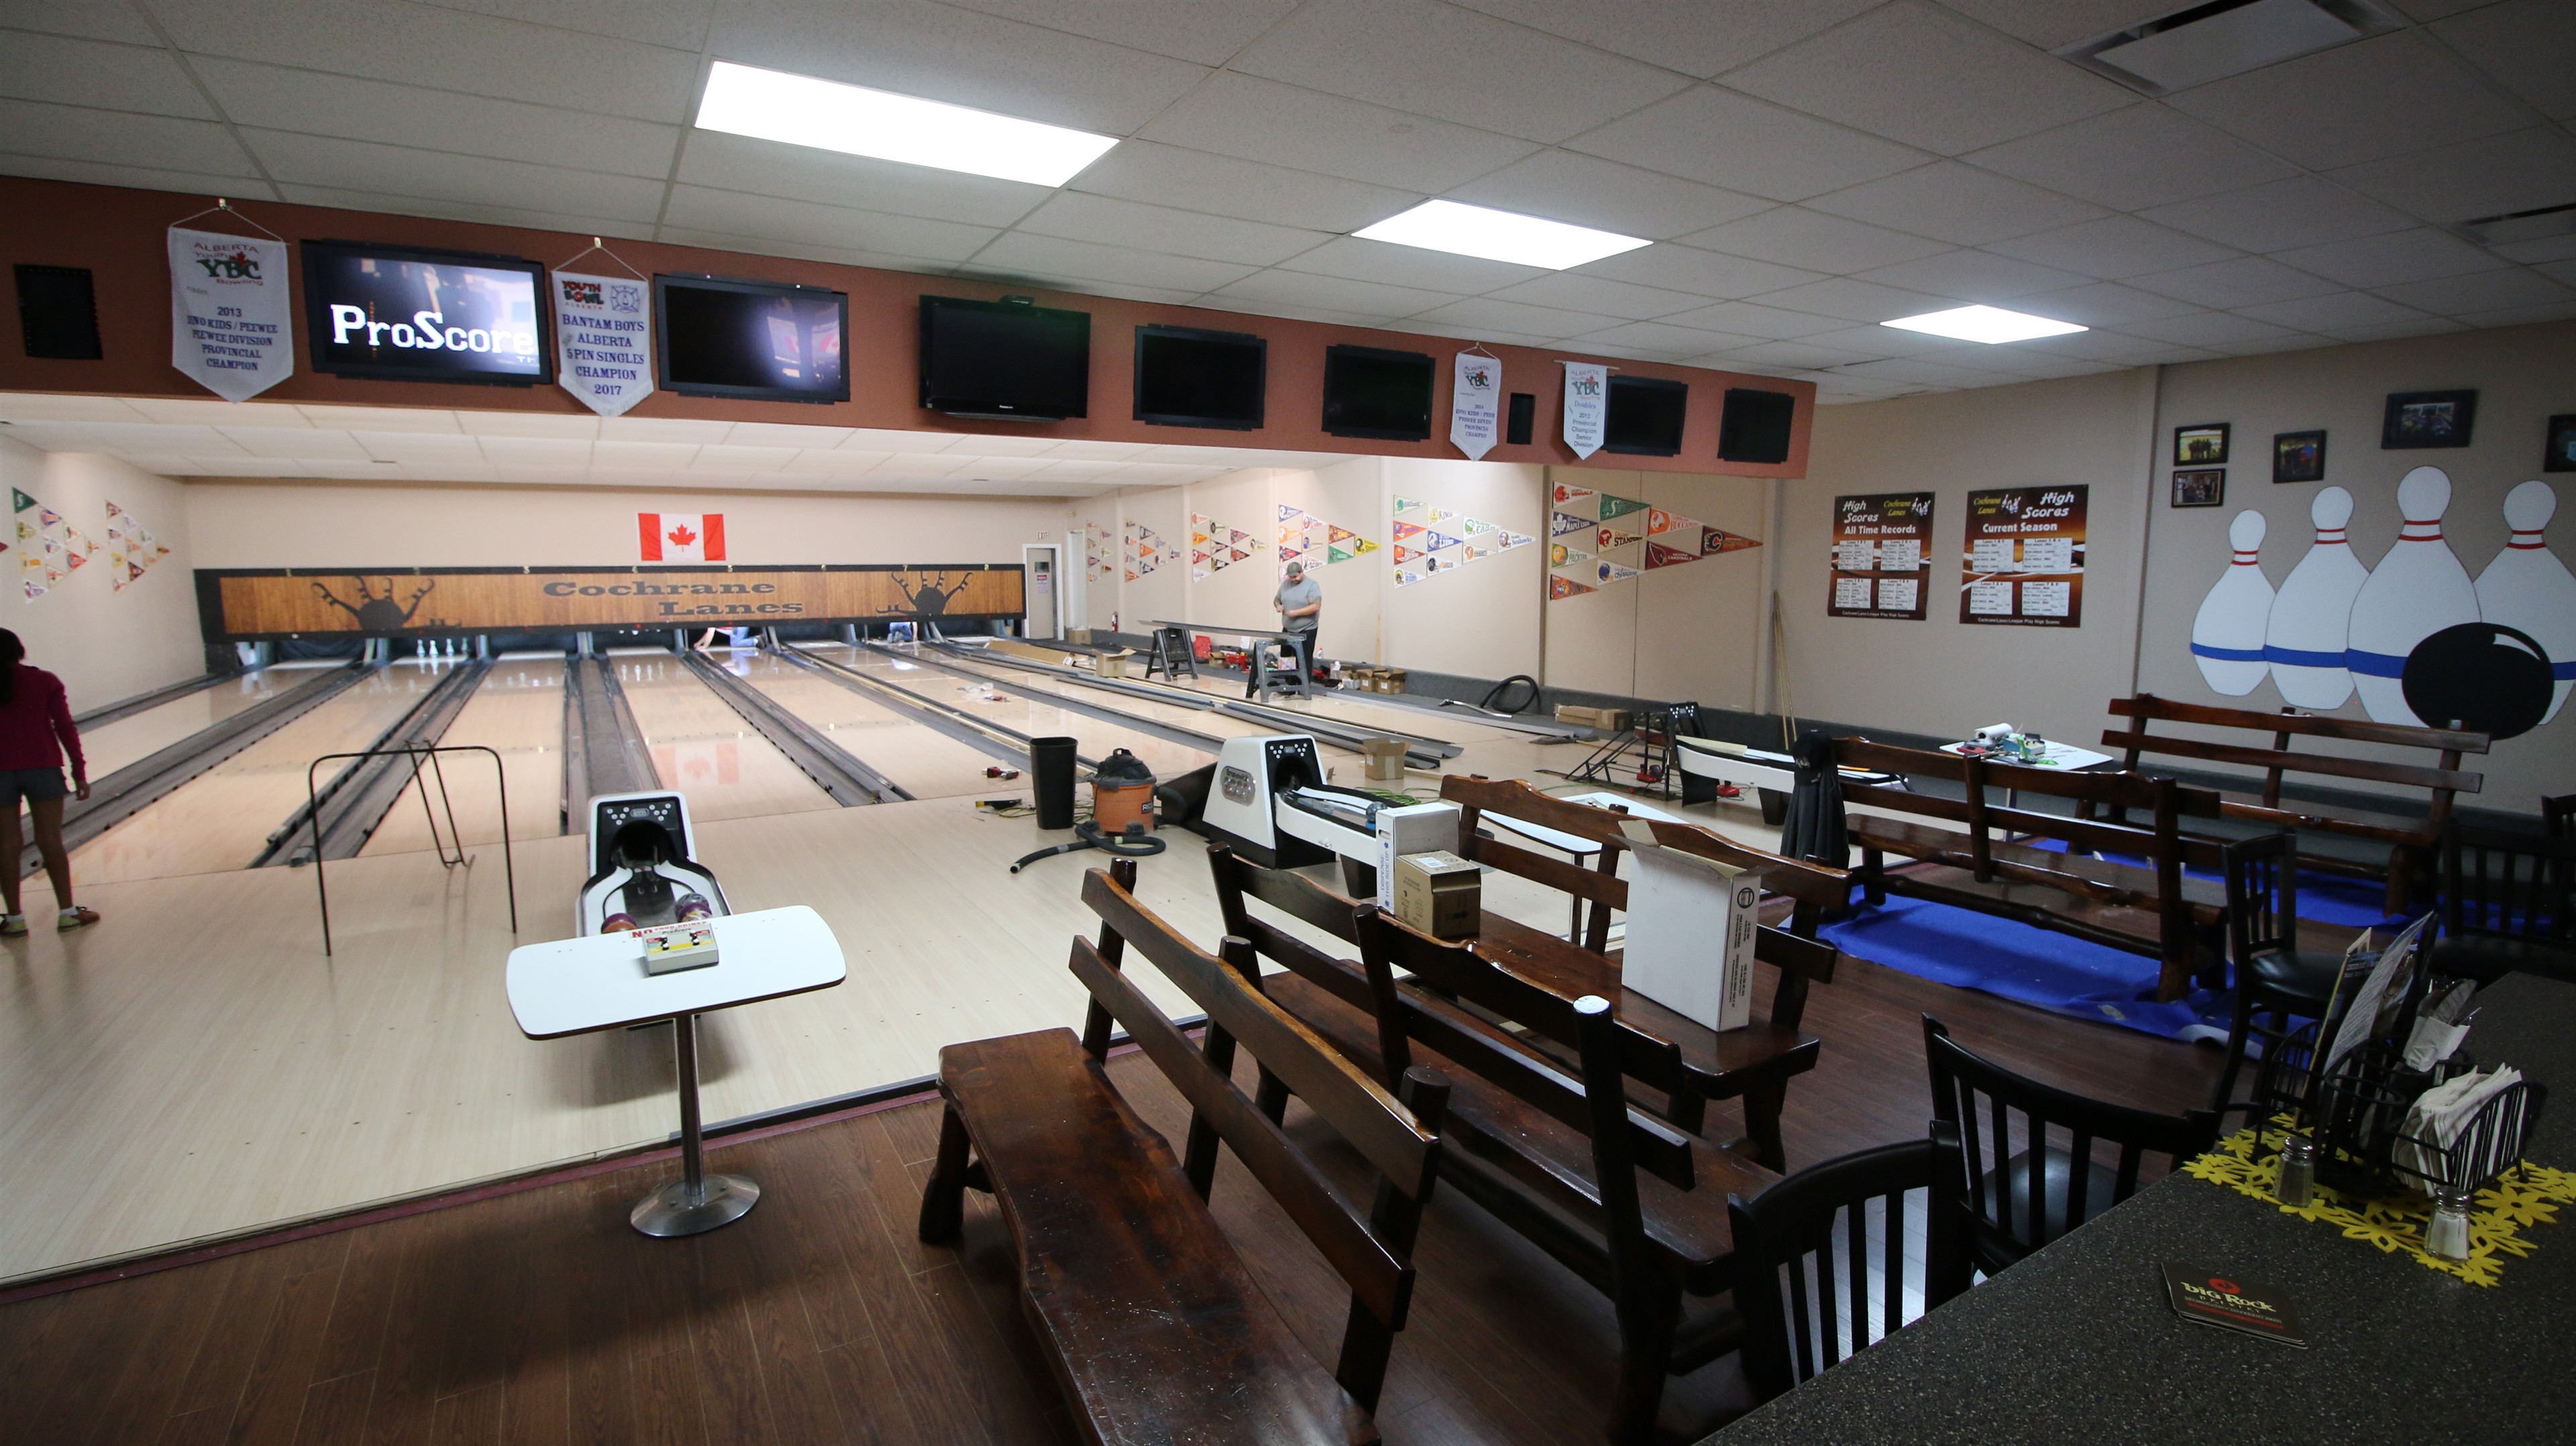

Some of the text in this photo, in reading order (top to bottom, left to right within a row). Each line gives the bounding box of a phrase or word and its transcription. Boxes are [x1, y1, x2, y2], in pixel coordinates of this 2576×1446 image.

[194, 243, 259, 254] ALBERTA
[196, 258, 262, 279] YBC
[562, 280, 601, 292] YOUTH
[564, 290, 604, 304] BOWL
[217, 307, 242, 317] 2013
[207, 319, 232, 330] KIDS
[239, 322, 278, 333] PEEWEE
[562, 314, 644, 331] BANTAM BOYS
[330, 304, 535, 355] ProScore
[229, 335, 272, 345] DIVISION
[578, 333, 633, 347] ALBERTA
[202, 343, 262, 358] PROVINCIAL
[566, 349, 644, 364] 5 PIN SINGLES
[207, 358, 258, 370] CHAMPION
[576, 366, 637, 380] CHAMPION
[1465, 376, 1490, 387] YBC
[594, 384, 622, 395] 2017
[1572, 381, 1600, 396] YBC
[1574, 401, 1596, 410] Doubles
[1843, 499, 1911, 512] High Cochrane
[1974, 492, 2074, 506] Cochrane High
[1844, 513, 1878, 523] Scores
[2021, 506, 2070, 519] Scores
[1566, 521, 1580, 532] MAPLE
[1844, 524, 1916, 535] All Time Records
[1982, 522, 2057, 533] Current Season
[543, 581, 775, 597] Cochrane
[659, 601, 804, 616] Lanes
[1385, 851, 1389, 861] UP
[632, 929, 653, 938] NO
